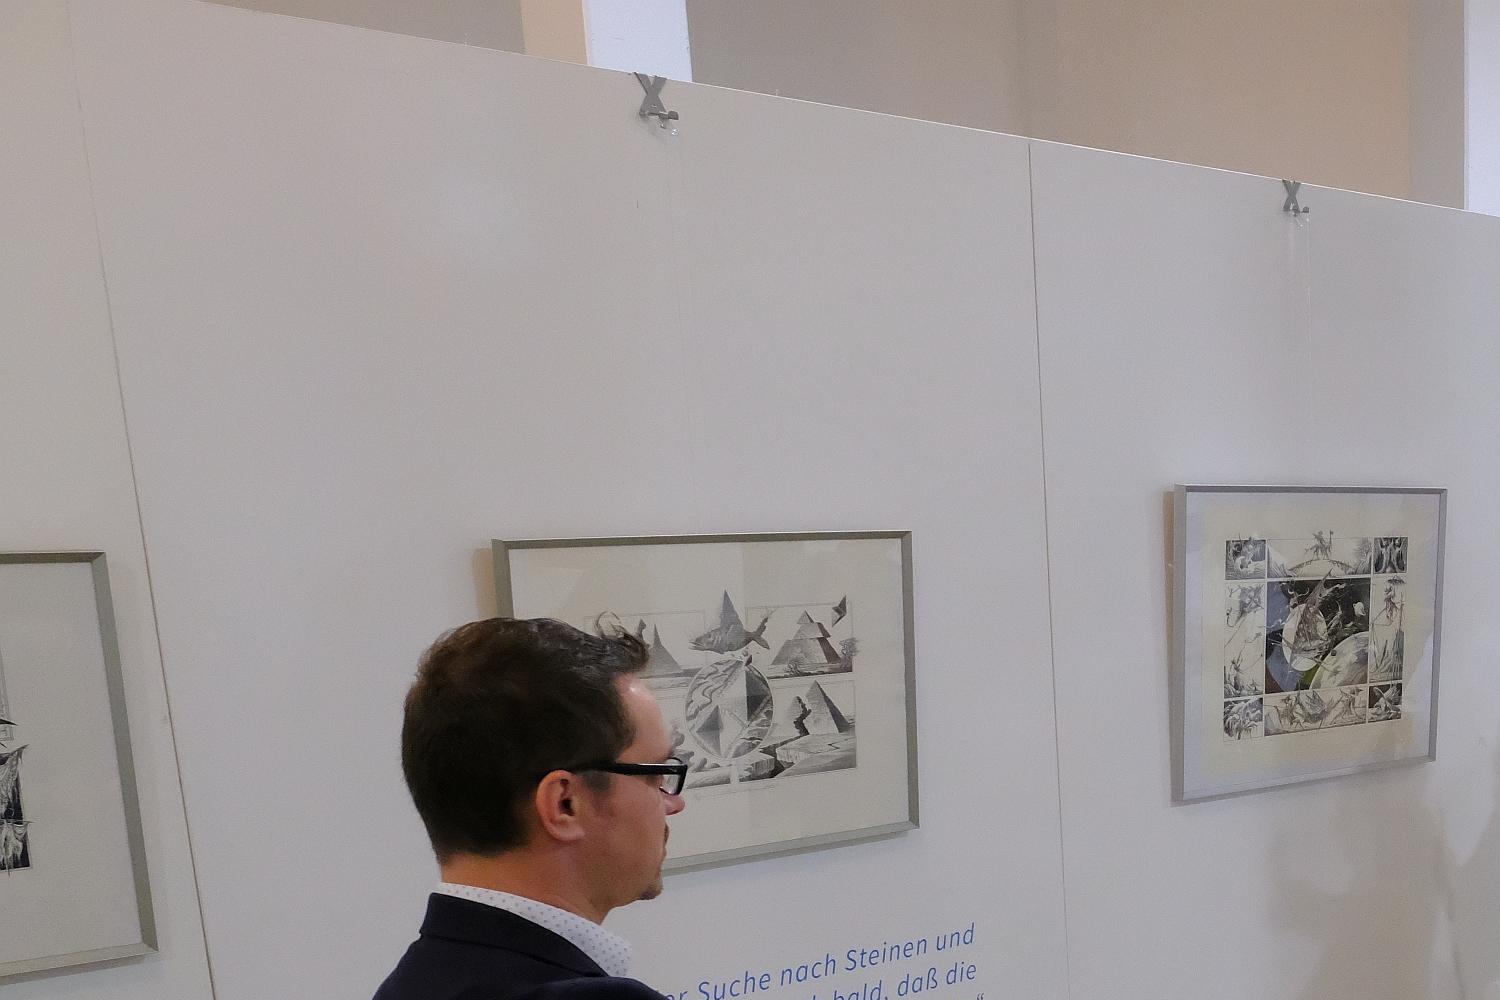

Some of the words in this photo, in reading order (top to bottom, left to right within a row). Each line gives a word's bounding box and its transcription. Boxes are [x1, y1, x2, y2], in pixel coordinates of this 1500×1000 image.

[780, 953, 837, 986] nach
[845, 938, 928, 972] Steinen
[936, 922, 976, 951] und
[897, 967, 938, 997] daß
[945, 961, 977, 985] die
